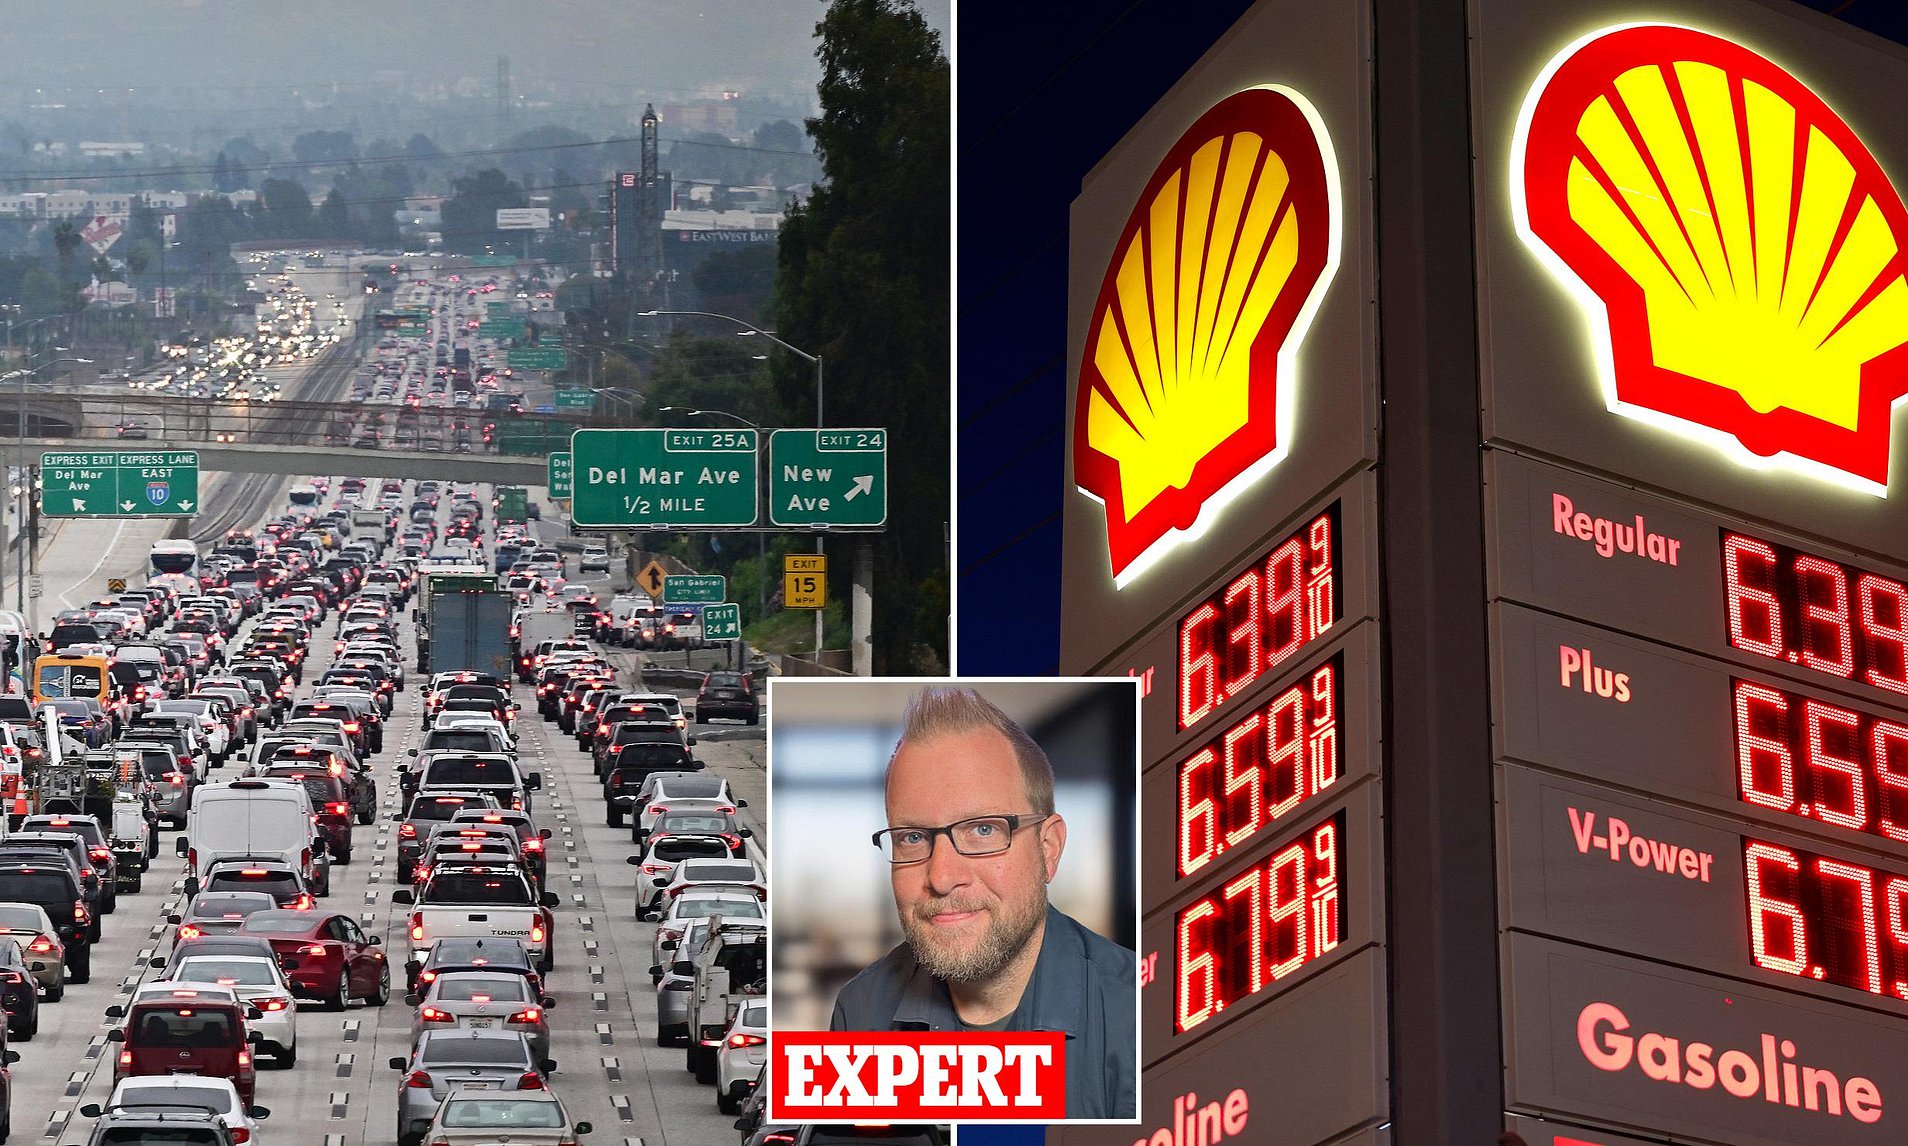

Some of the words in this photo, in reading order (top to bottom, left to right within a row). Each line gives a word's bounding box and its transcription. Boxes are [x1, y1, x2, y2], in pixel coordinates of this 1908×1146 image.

[673, 436, 703, 445] EXIT
[712, 434, 748, 447] 25A
[821, 436, 851, 445] EXIT
[857, 434, 882, 447] 24
[44, 456, 88, 465] EXPRESS
[92, 456, 114, 464] EXIT
[120, 456, 164, 464] EXPRESS
[169, 455, 195, 464] LANE
[55, 471, 74, 479] Del
[80, 470, 103, 479] Mar
[142, 469, 173, 478] EAST
[588, 467, 626, 484] Del
[639, 467, 684, 484] Mar
[698, 467, 740, 484] Ave
[784, 465, 832, 481] New
[68, 482, 90, 490] Ave
[151, 490, 164, 500] 10
[660, 499, 705, 511] MILE
[787, 494, 830, 511] Ave
[1552, 492, 1681, 567] Regular
[793, 560, 817, 568] EXIT
[794, 577, 816, 593] 15
[706, 610, 734, 620] EXIT
[707, 625, 721, 635] 24
[1182, 538, 1302, 727] 6.39
[1559, 645, 1632, 703] Plus
[1180, 688, 1303, 876] 6.59
[1567, 806, 1713, 883] V-Power
[1180, 844, 1306, 1031] 6.79
[1576, 1001, 1883, 1123] Gasoline
